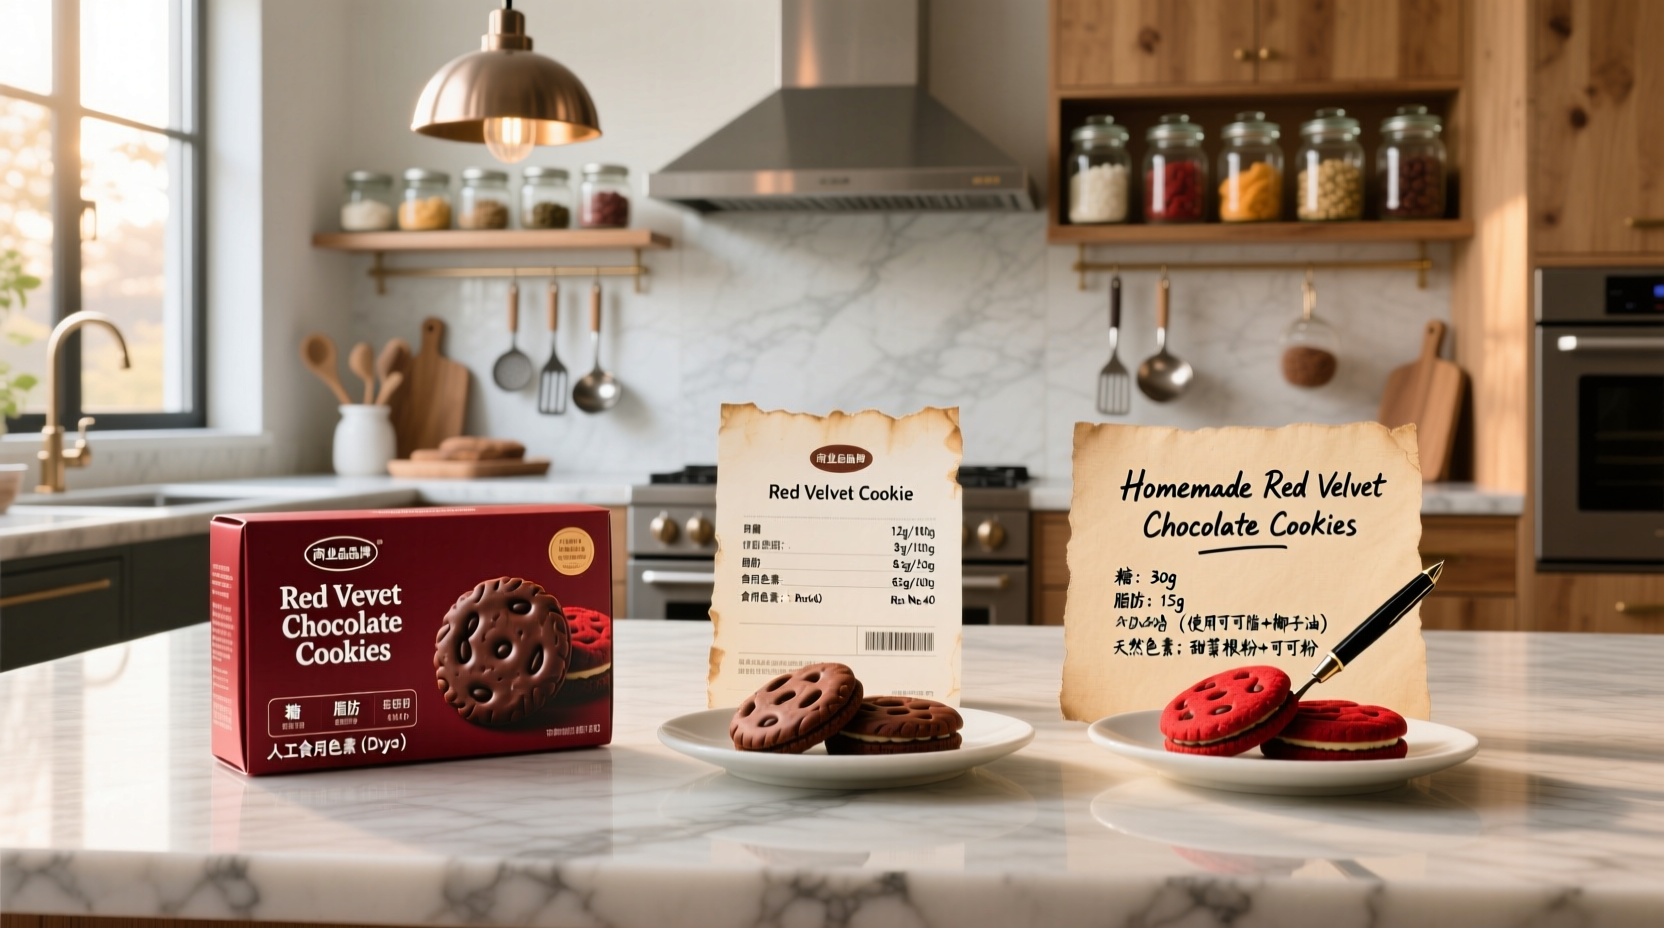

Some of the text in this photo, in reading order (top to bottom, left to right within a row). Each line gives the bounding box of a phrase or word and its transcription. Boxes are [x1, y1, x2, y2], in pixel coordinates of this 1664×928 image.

[769, 484, 914, 501] Red Velvet Cookie
[1120, 468, 1387, 502] Homemade Red Velvet
[1143, 509, 1357, 538] Chocolate Cookies
[1150, 570, 1177, 590] 30g
[279, 583, 402, 610] Red Vevet
[1161, 594, 1185, 613] 15g
[282, 610, 402, 638] Chocolate
[295, 639, 391, 666] Cookies
[333, 700, 361, 717] 脂肪
